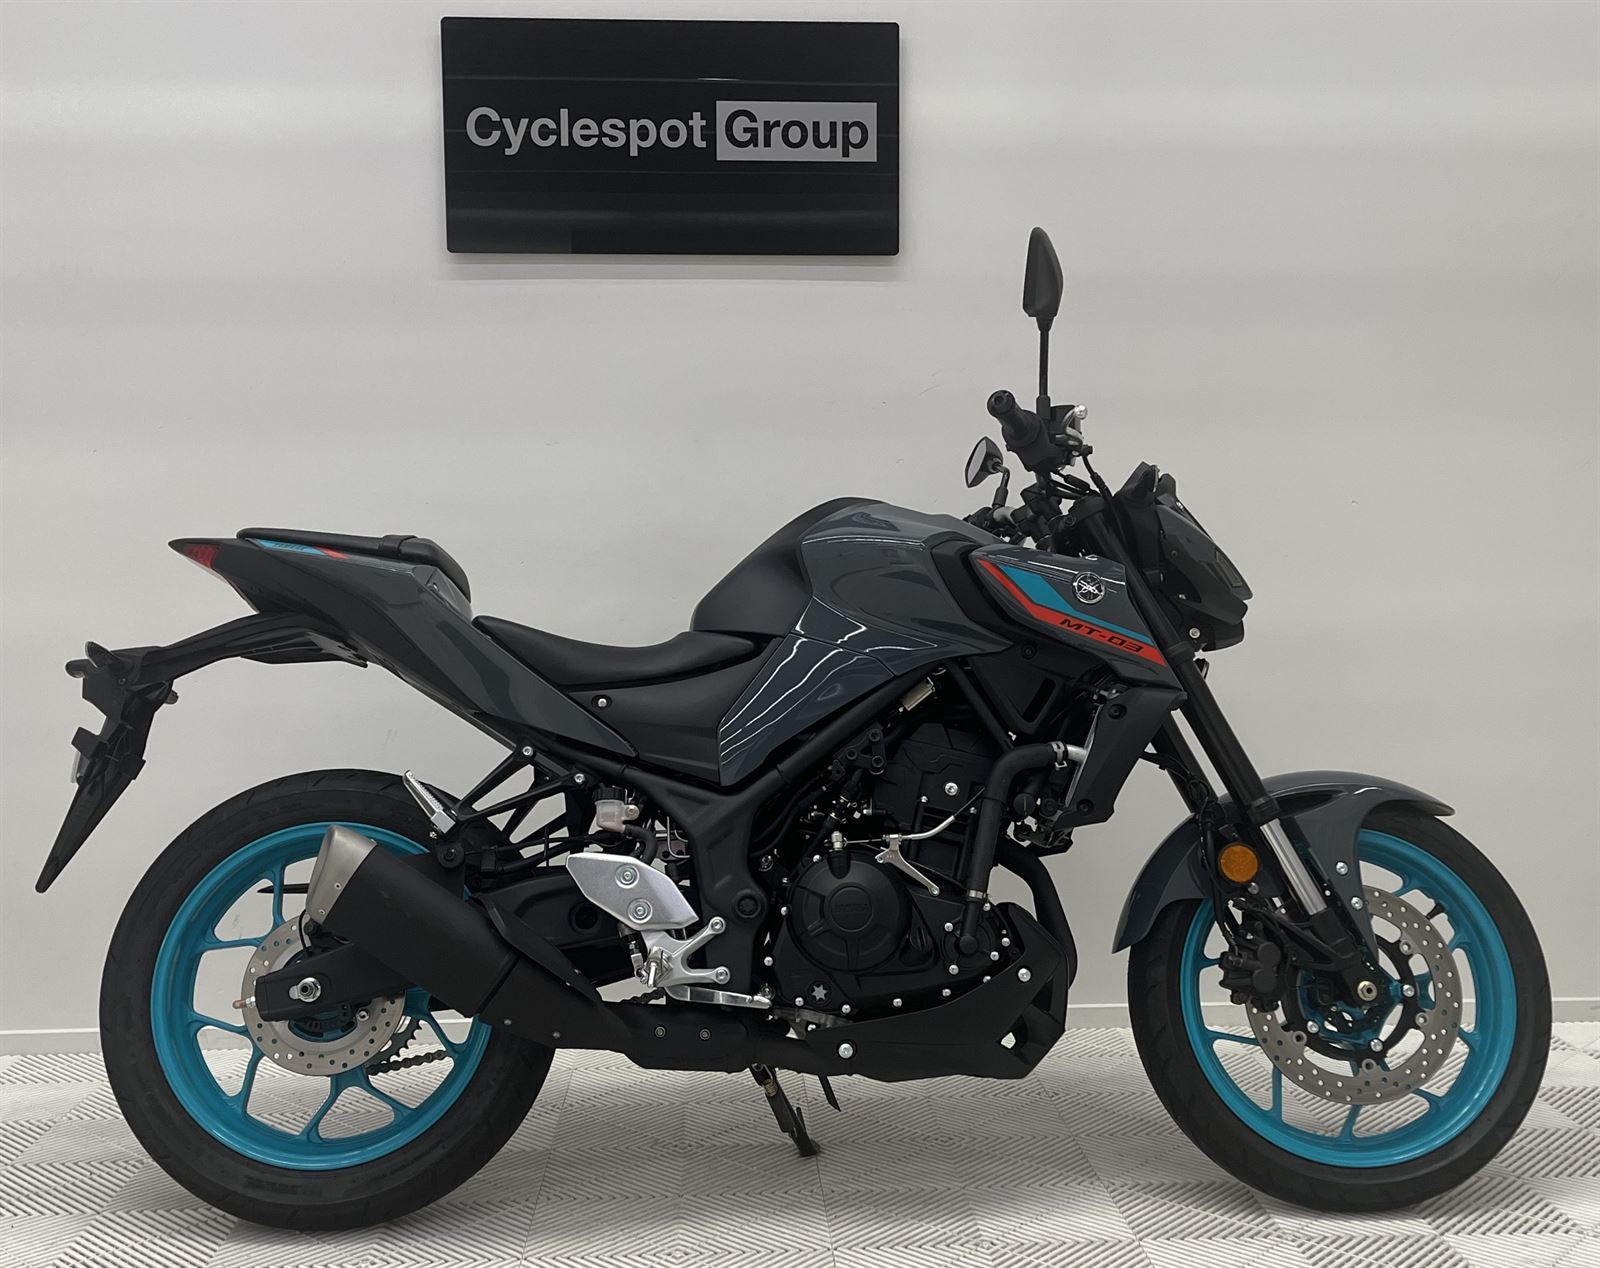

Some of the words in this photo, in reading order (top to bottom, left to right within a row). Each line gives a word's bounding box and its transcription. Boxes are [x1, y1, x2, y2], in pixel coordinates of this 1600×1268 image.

[465, 106, 708, 157] Cyclespot
[724, 109, 869, 158] Group
[1059, 618, 1144, 653] MT-03
